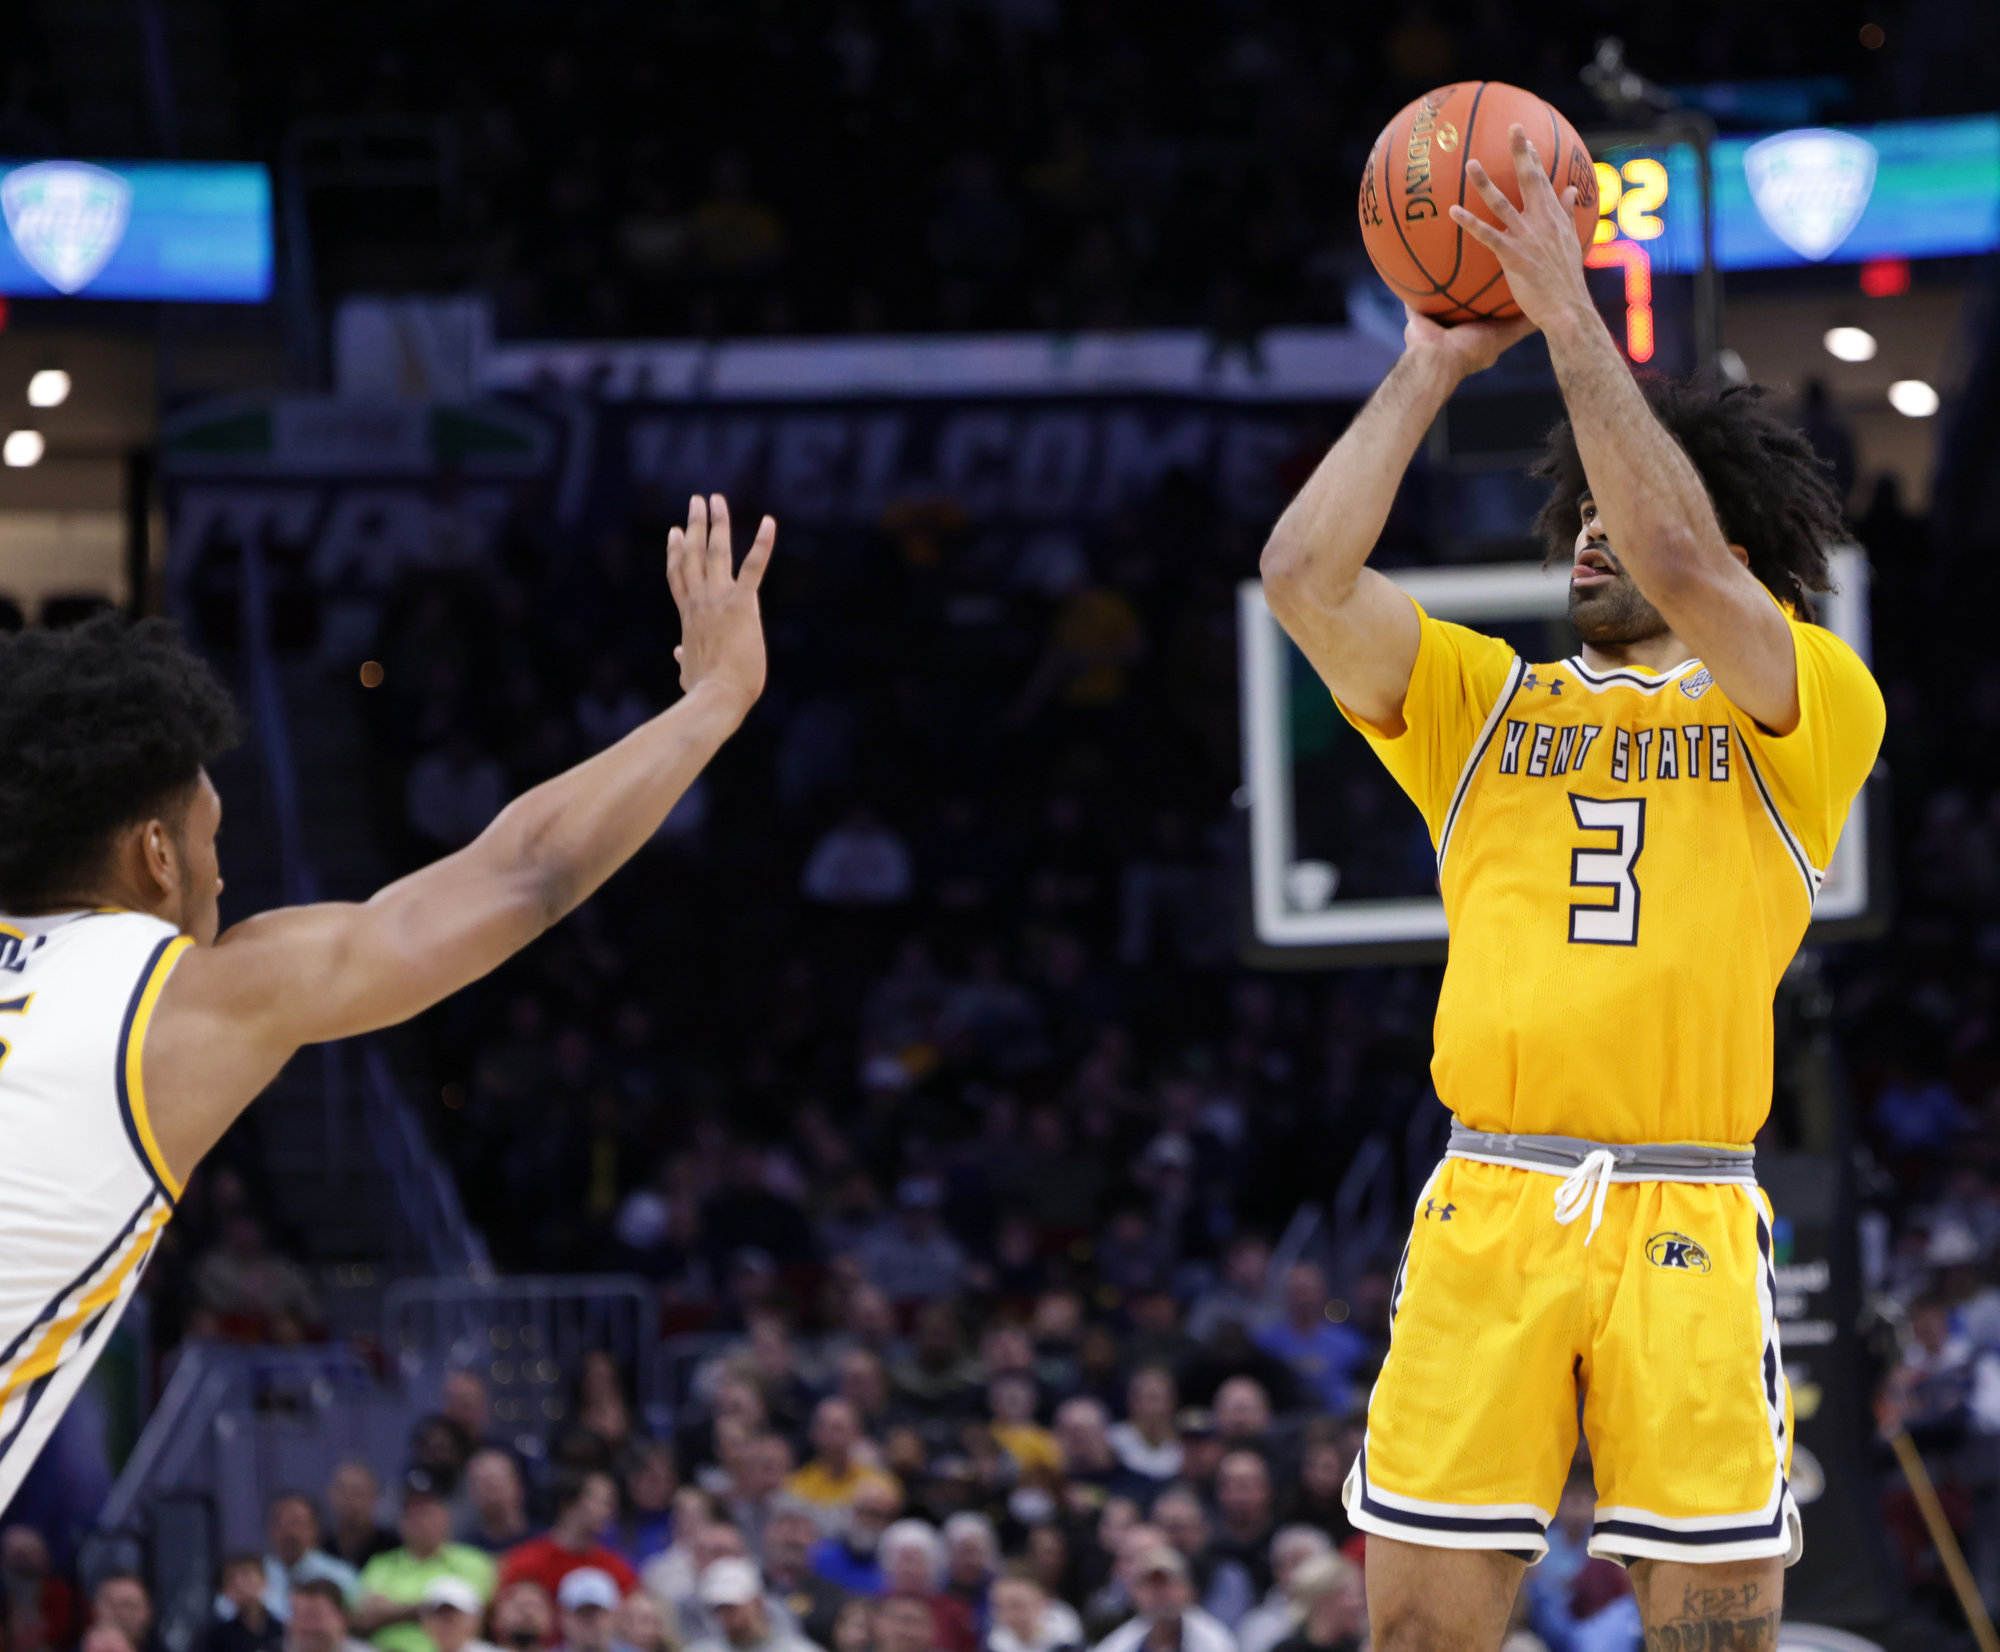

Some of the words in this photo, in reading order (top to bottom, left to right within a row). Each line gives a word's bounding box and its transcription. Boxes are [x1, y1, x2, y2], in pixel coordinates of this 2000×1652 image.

[1499, 718, 1603, 778] KENT
[1611, 724, 1730, 783] STATE
[1567, 791, 1647, 947] 3
[1661, 1241, 1692, 1269] K
